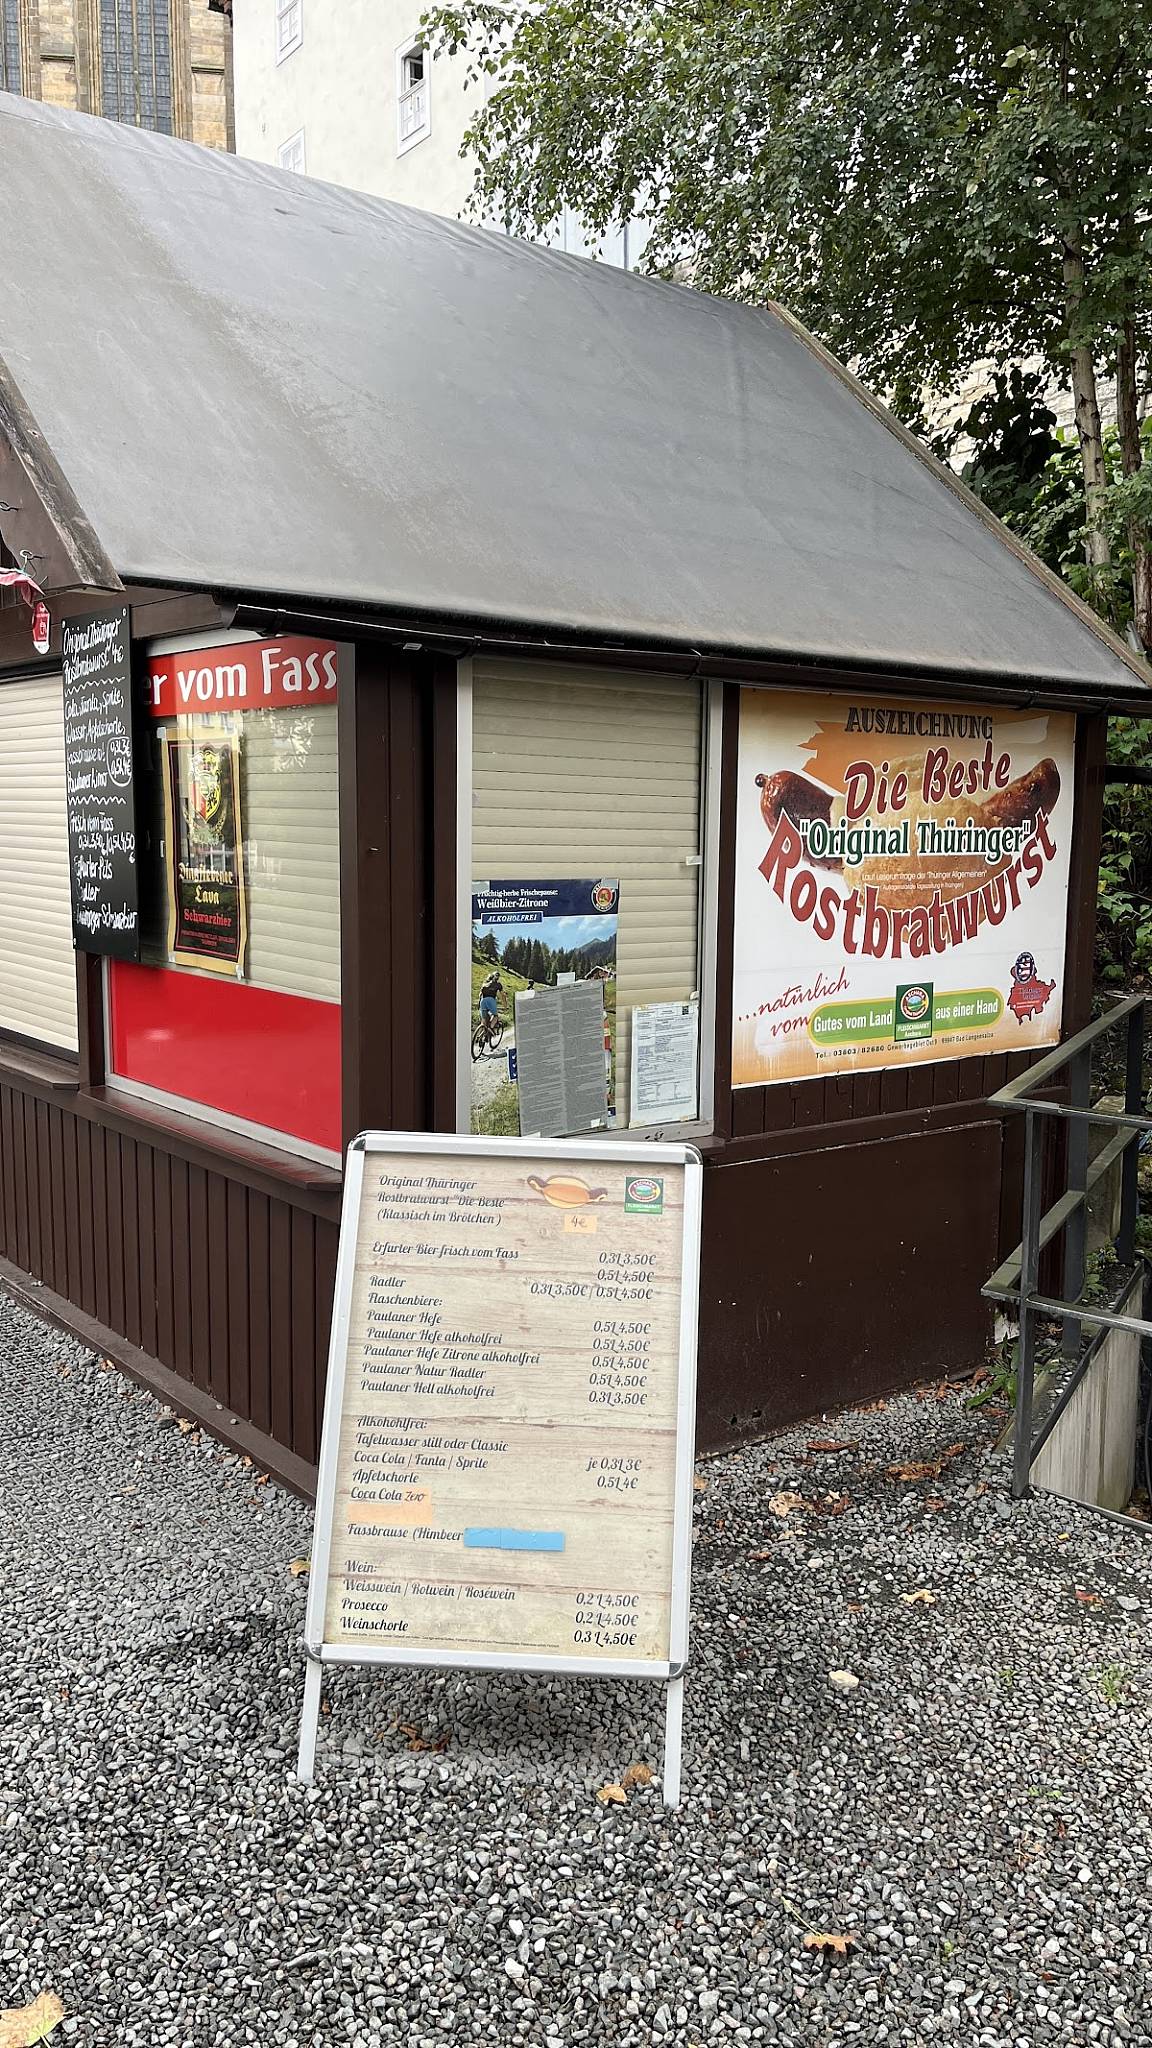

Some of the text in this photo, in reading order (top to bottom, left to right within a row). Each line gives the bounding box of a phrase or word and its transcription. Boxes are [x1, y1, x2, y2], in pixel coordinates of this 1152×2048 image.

[177, 663, 247, 703] vom
[261, 647, 337, 695] Fass
[845, 707, 993, 739] AUSZEICHNUNG
[845, 740, 1011, 820] Die Beste
[801, 819, 1030, 864] "Original Thüringer"
[758, 808, 1057, 958] Rostbratwurst
[195, 885, 220, 905] Lava
[477, 898, 549, 909] Weißbier-Zitrone
[183, 909, 232, 927] Schwarzbier
[487, 914, 538, 923] ALKOHOLFREI
[814, 1016, 843, 1033] Gutes
[845, 1015, 867, 1029] vom
[869, 1011, 893, 1027] Land
[935, 1007, 951, 1019] aus
[952, 1001, 975, 1018] einer
[976, 998, 998, 1015] Hand
[770, 1016, 811, 1037] vom
[379, 1175, 477, 1192] Original Thüringer
[377, 1192, 450, 1205] Rostbratwurst
[377, 1208, 430, 1221] (Klassisch
[432, 1211, 446, 1221] im
[373, 1240, 519, 1259] Erfurter Bier frisch vom Fass
[370, 1274, 406, 1288] Radler
[368, 1292, 443, 1307] Flaschenbiere:
[366, 1310, 442, 1326] Paulaner Hefe
[366, 1327, 502, 1347] Paulaner Hefe alkoholfrei
[363, 1343, 540, 1366] Paulaner Hefe Zitrone alkoholfrei
[362, 1361, 486, 1379] Paulaner Natur Radler
[360, 1379, 496, 1400] Paulaner Hell alkoholfrei
[355, 1432, 509, 1452] Tafelwasser still oder Classic
[354, 1450, 489, 1471] Coca Cola / Fanta / Sprite
[585, 1457, 598, 1472] je
[352, 1468, 419, 1484] Apfelschorle
[351, 1486, 376, 1500] Coca
[379, 1488, 403, 1501] Cola
[347, 1523, 464, 1542] Fassbrause (Himbeer
[344, 1559, 377, 1573] Wein:
[343, 1578, 402, 1594] Weisswein
[403, 1582, 409, 1597] /
[411, 1583, 455, 1597] Rotwein
[457, 1585, 463, 1600] /
[341, 1598, 388, 1612] Prosecco
[339, 1616, 409, 1632] Weinschorle
